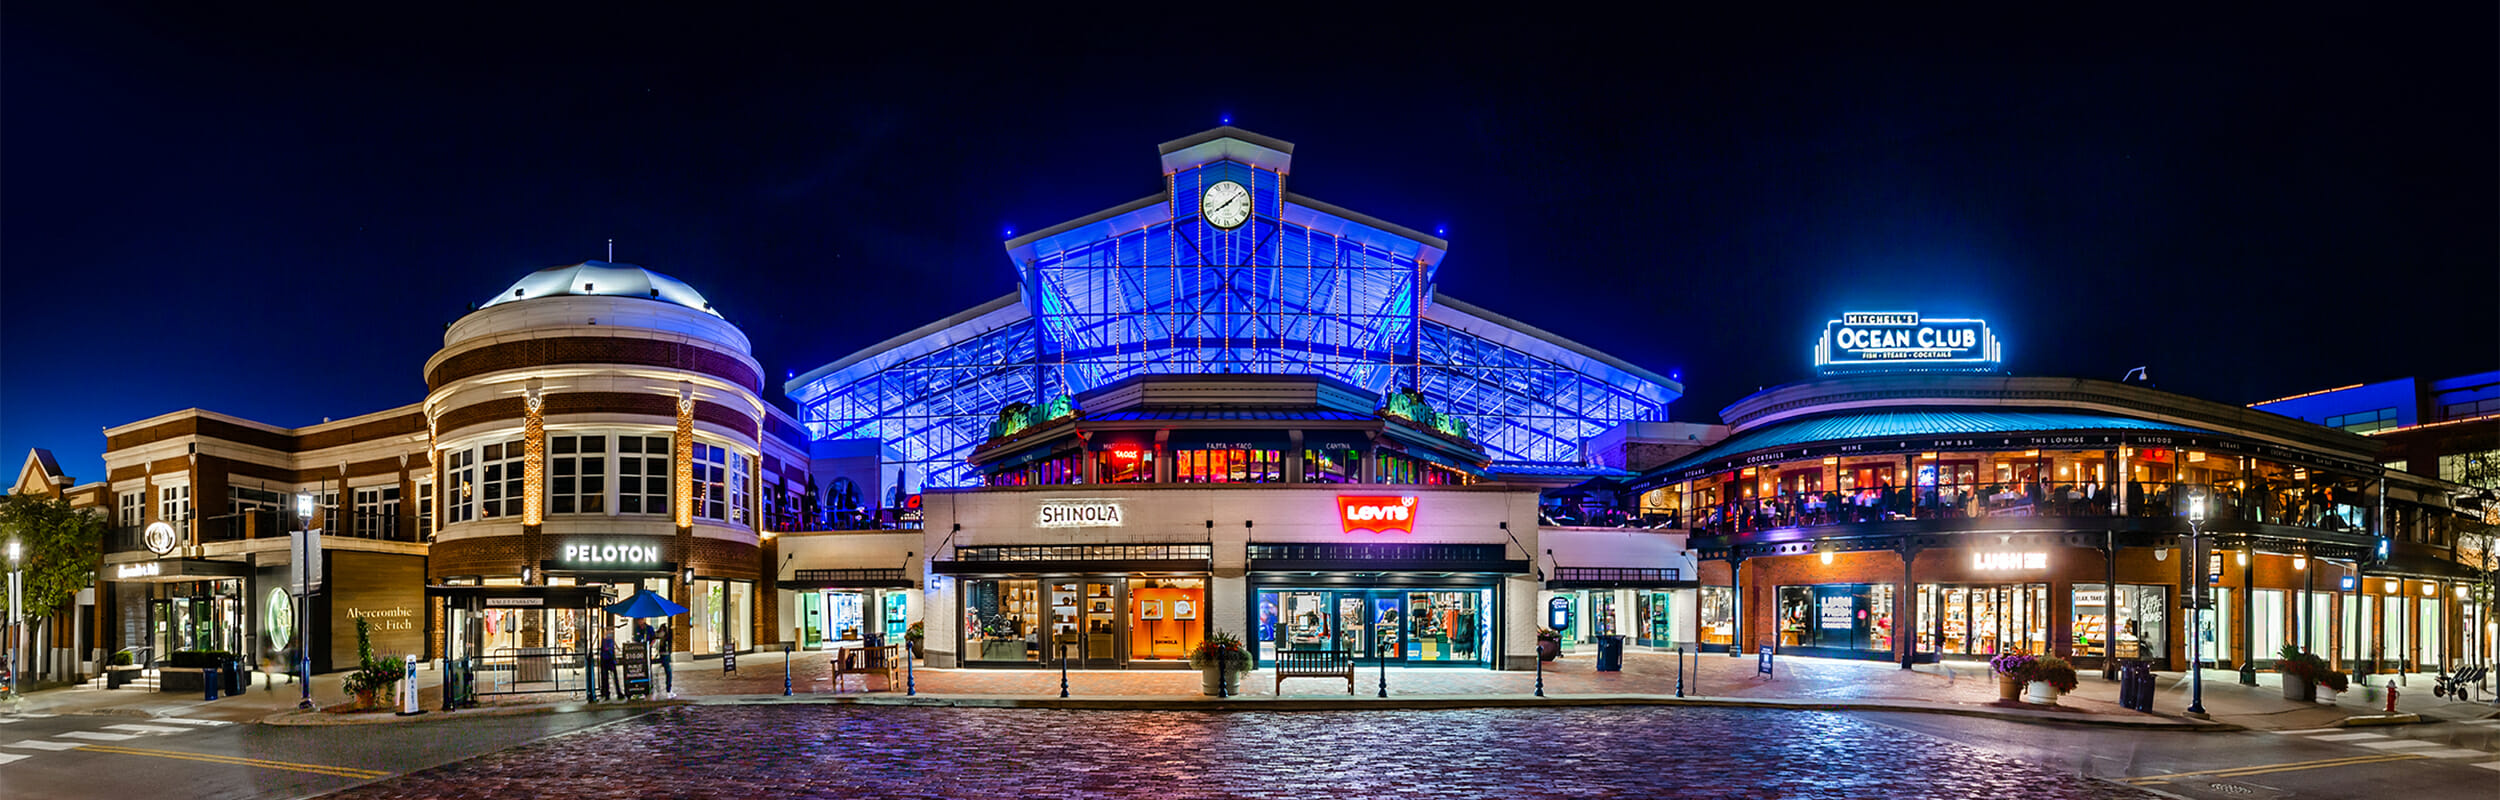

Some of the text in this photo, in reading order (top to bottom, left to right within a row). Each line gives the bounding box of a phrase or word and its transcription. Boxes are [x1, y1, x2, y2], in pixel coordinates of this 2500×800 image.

[1849, 315, 1913, 324] MITCHELL'S
[1837, 327, 1977, 349] OCEAN CLUB
[1913, 351, 1952, 359] COCKTAILS
[2051, 436, 2084, 444] LOUNGE
[2138, 436, 2172, 445] SEAFOOD
[1841, 444, 1862, 452] WINE
[1746, 452, 1784, 464] COCKTAILS
[1042, 506, 1119, 523] SHINOLA
[565, 544, 658, 563] PELOTON
[1973, 552, 2023, 570] LUSH
[346, 606, 412, 618] Abercrombie
[374, 618, 412, 631] & Fitch
